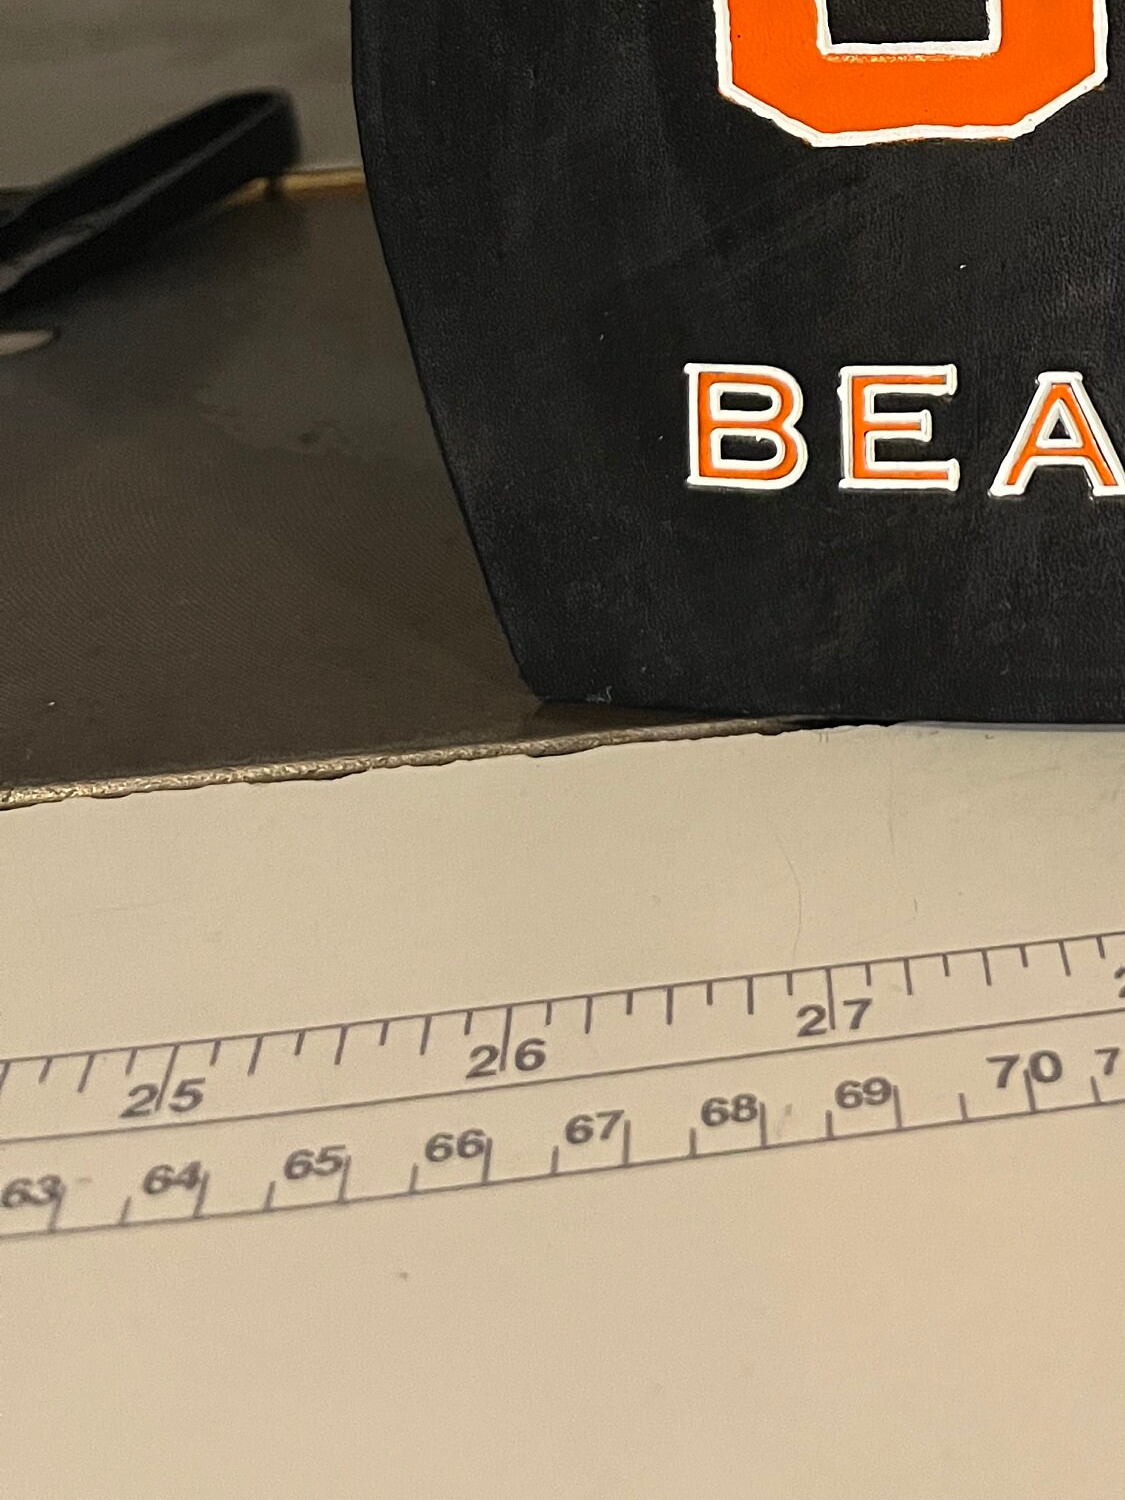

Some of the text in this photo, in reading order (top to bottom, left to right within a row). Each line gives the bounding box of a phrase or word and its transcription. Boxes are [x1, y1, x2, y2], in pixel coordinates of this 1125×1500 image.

[120, 1076, 206, 1118] 25
[465, 1038, 547, 1079] 26
[796, 998, 873, 1037] 27
[142, 1161, 203, 1196] 64
[283, 1144, 346, 1180] 65
[424, 1128, 486, 1163] 66
[565, 1109, 625, 1144] 67
[701, 1092, 759, 1127] 68
[834, 1076, 892, 1109] 69
[986, 1049, 1063, 1088] 70
